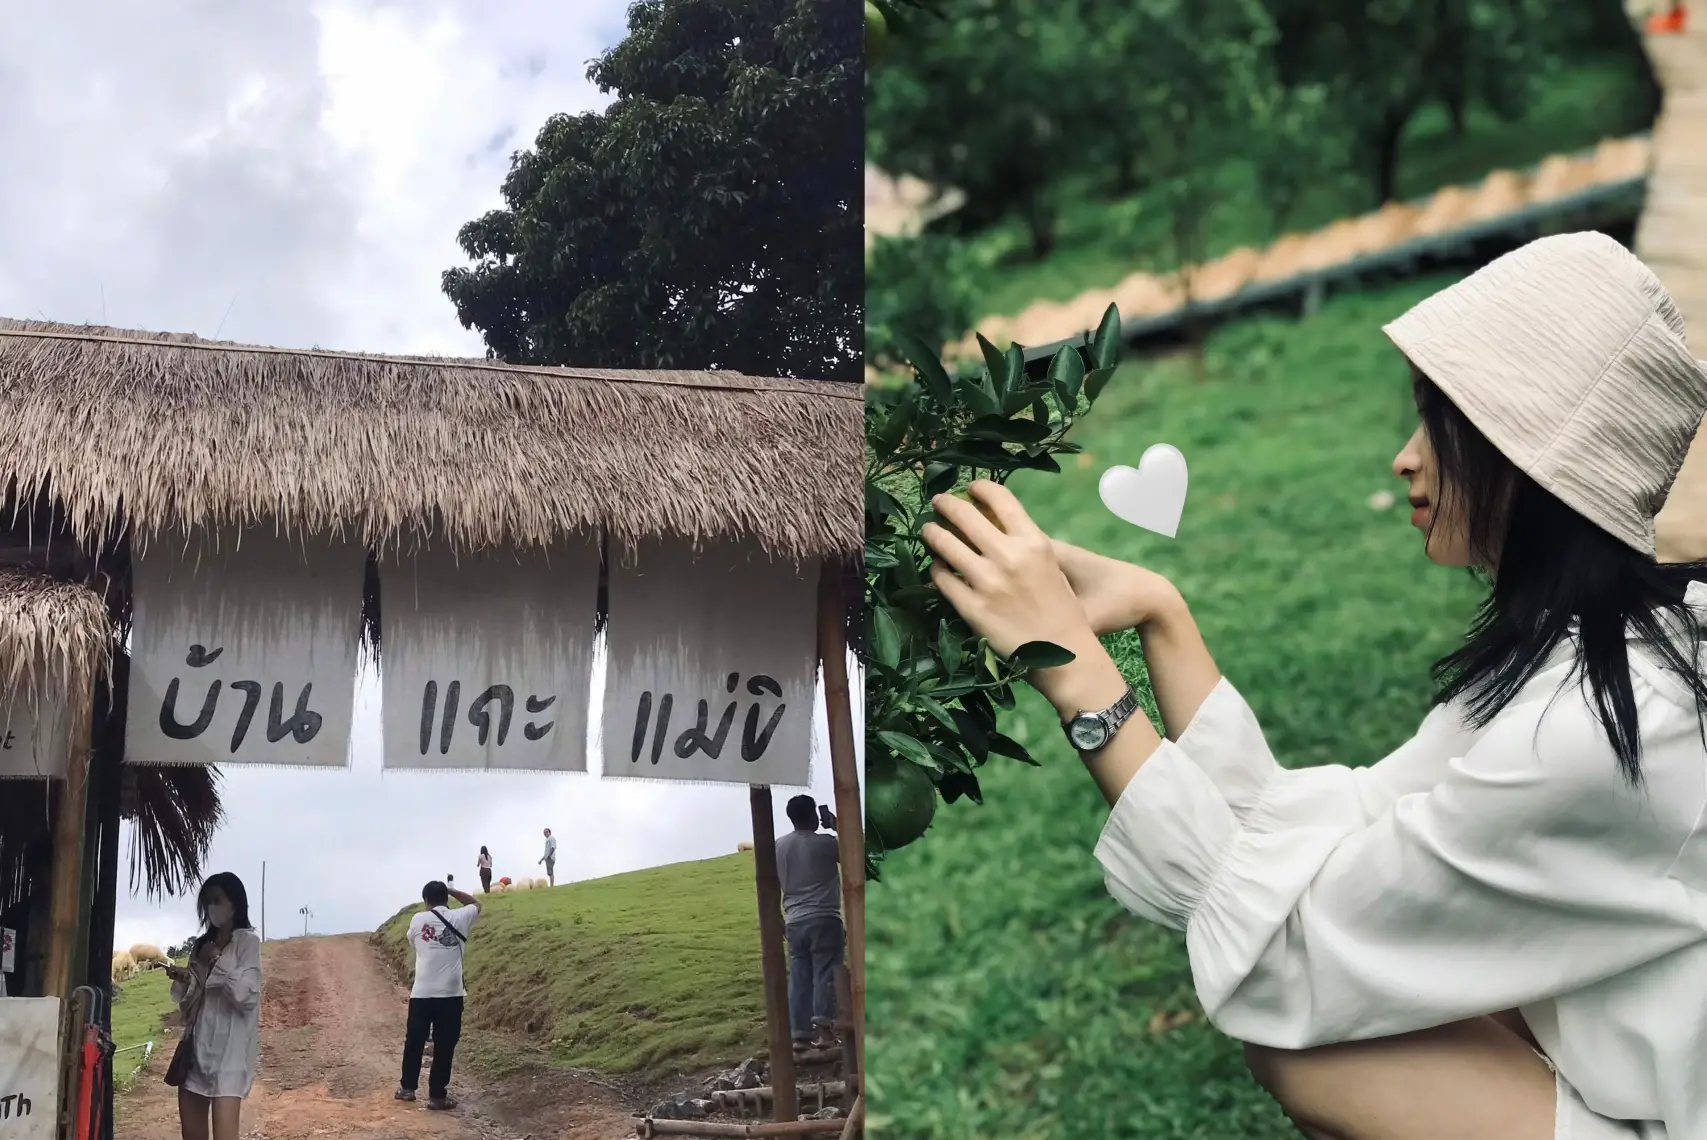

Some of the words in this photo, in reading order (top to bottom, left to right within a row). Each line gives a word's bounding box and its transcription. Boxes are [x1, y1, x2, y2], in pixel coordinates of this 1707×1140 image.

[159, 644, 323, 754] บ้าน
[420, 680, 557, 755] แกะ
[0, 1092, 32, 1120] Th
